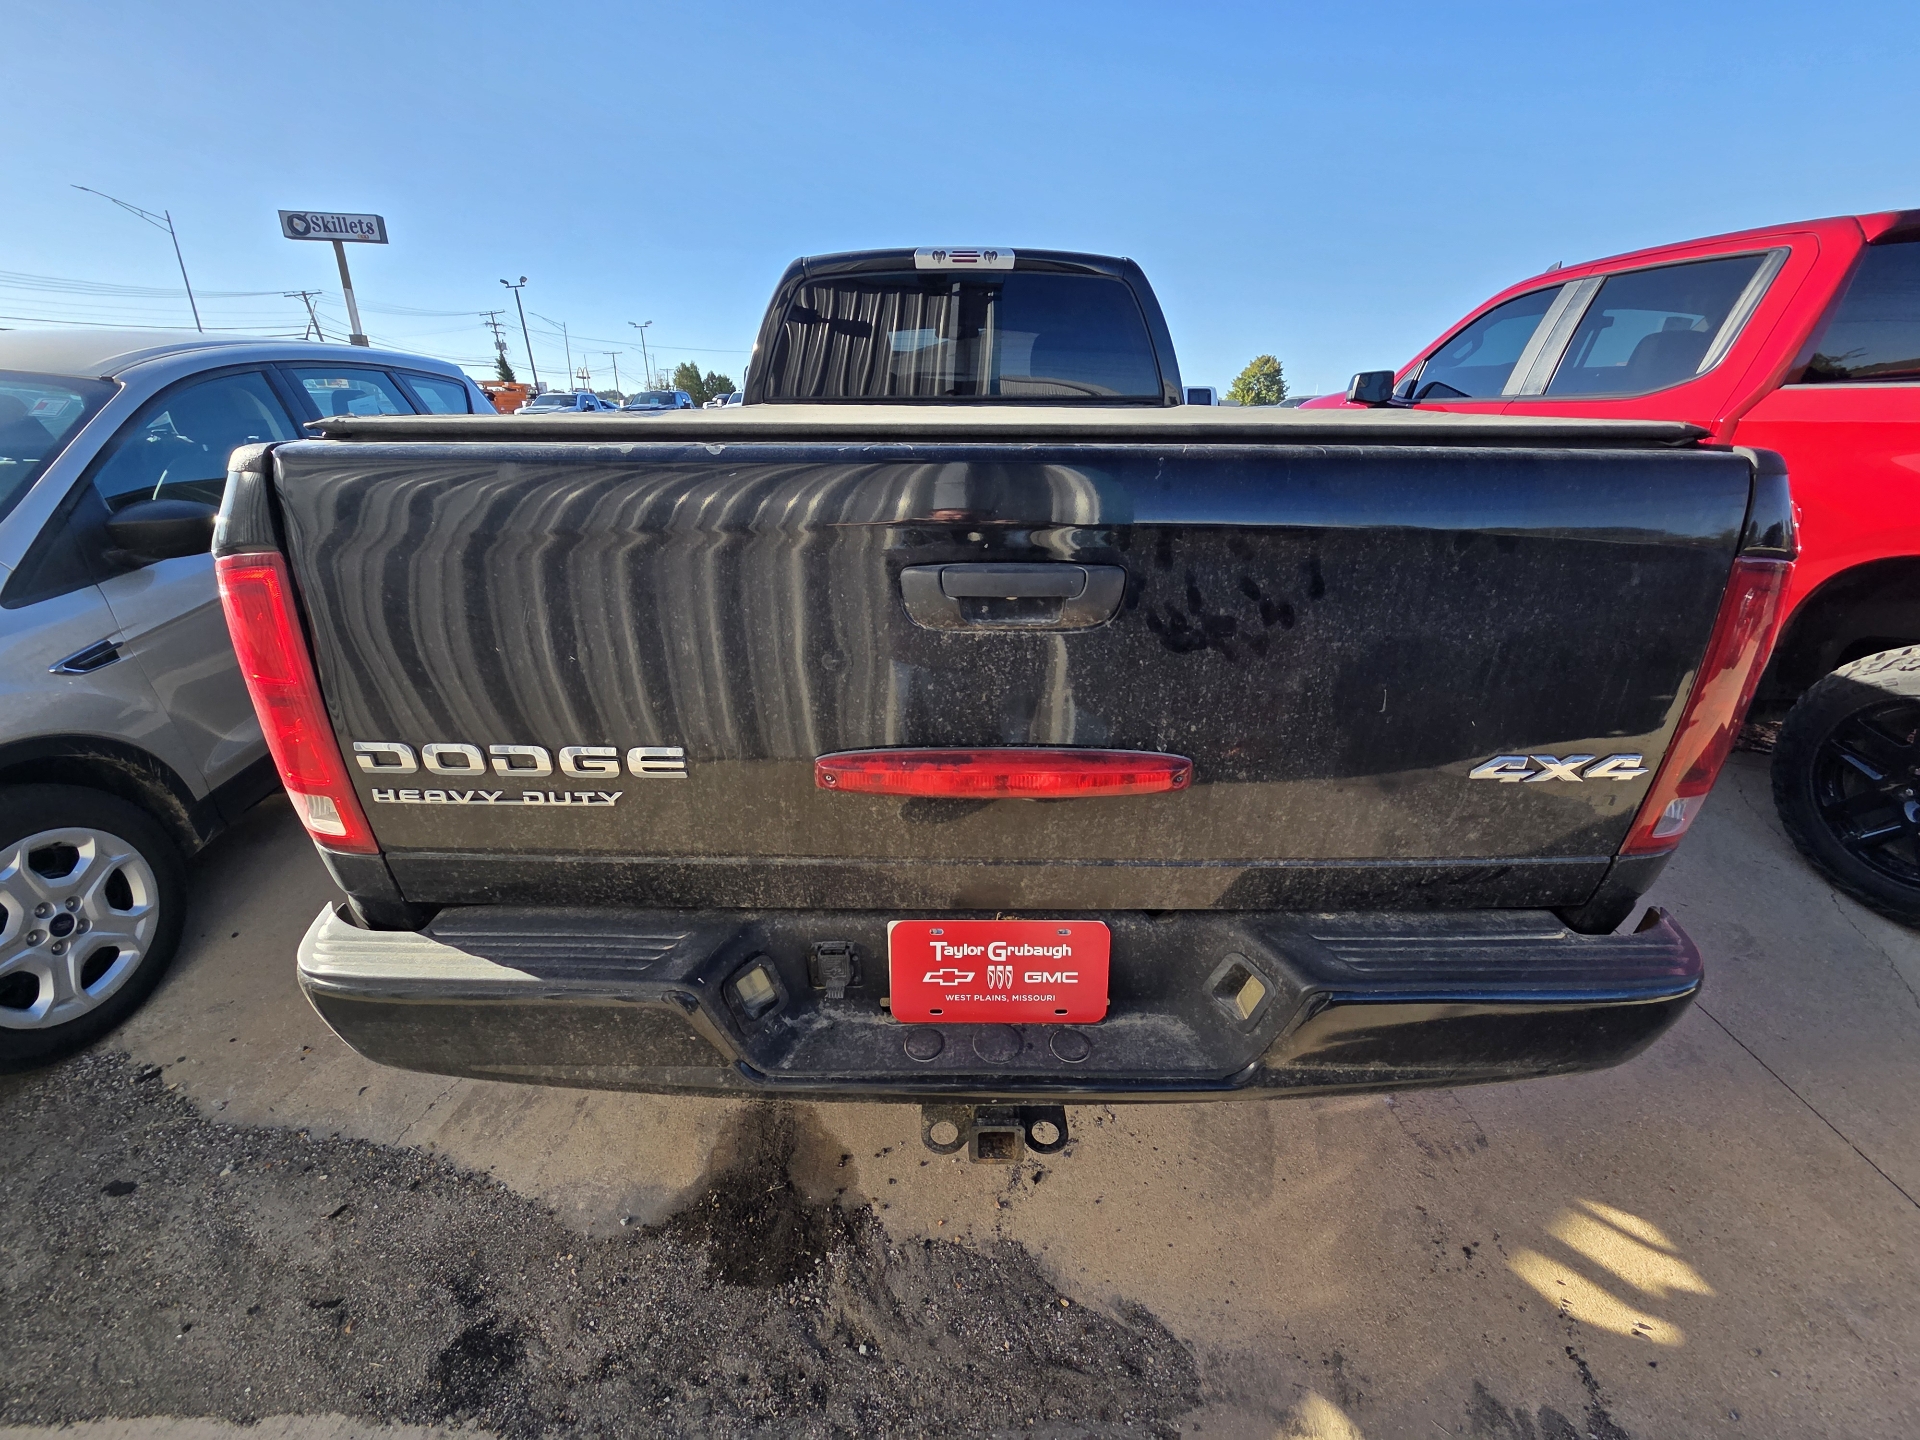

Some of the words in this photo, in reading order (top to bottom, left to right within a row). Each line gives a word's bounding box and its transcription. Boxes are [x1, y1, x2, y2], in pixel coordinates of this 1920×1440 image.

[310, 215, 375, 235] Skillets
[353, 741, 689, 779] DODGE
[371, 788, 504, 805] HEAVY
[522, 791, 623, 806] DUTY
[930, 941, 985, 962] Taylor
[987, 941, 1072, 962] Grubaugh
[1024, 971, 1079, 984] GMC
[945, 994, 972, 1002] WEST
[974, 994, 1009, 1003] PLAINS,
[1012, 994, 1056, 1002] MISSOURI
